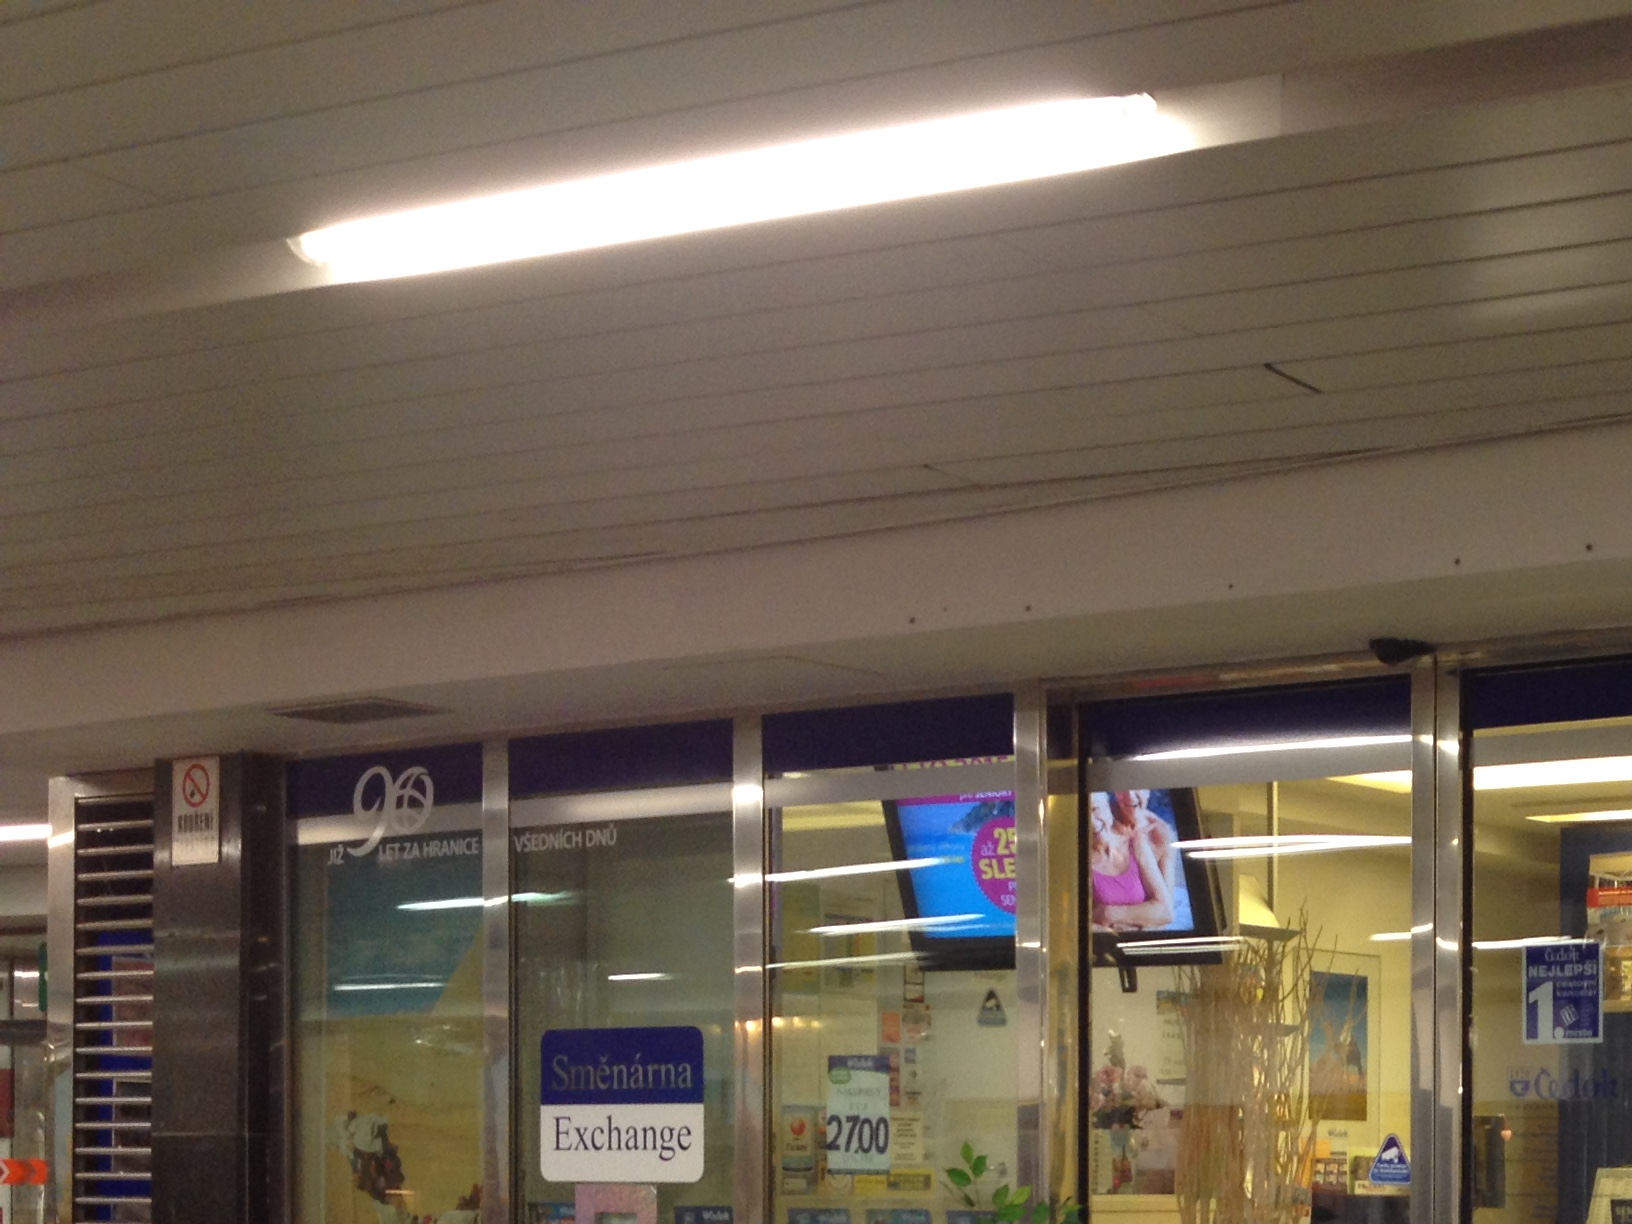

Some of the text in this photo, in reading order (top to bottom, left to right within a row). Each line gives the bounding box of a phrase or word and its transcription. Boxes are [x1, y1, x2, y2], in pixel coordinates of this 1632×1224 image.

[328, 823, 618, 866] JIŽ LET ZA HRANICE VŠEDNÍCH DNŮ
[979, 858, 1016, 879] SLE
[1528, 961, 1597, 977] NEJLEPŠÍ
[552, 1053, 693, 1091] Směnárna
[554, 1115, 693, 1161] Exchange
